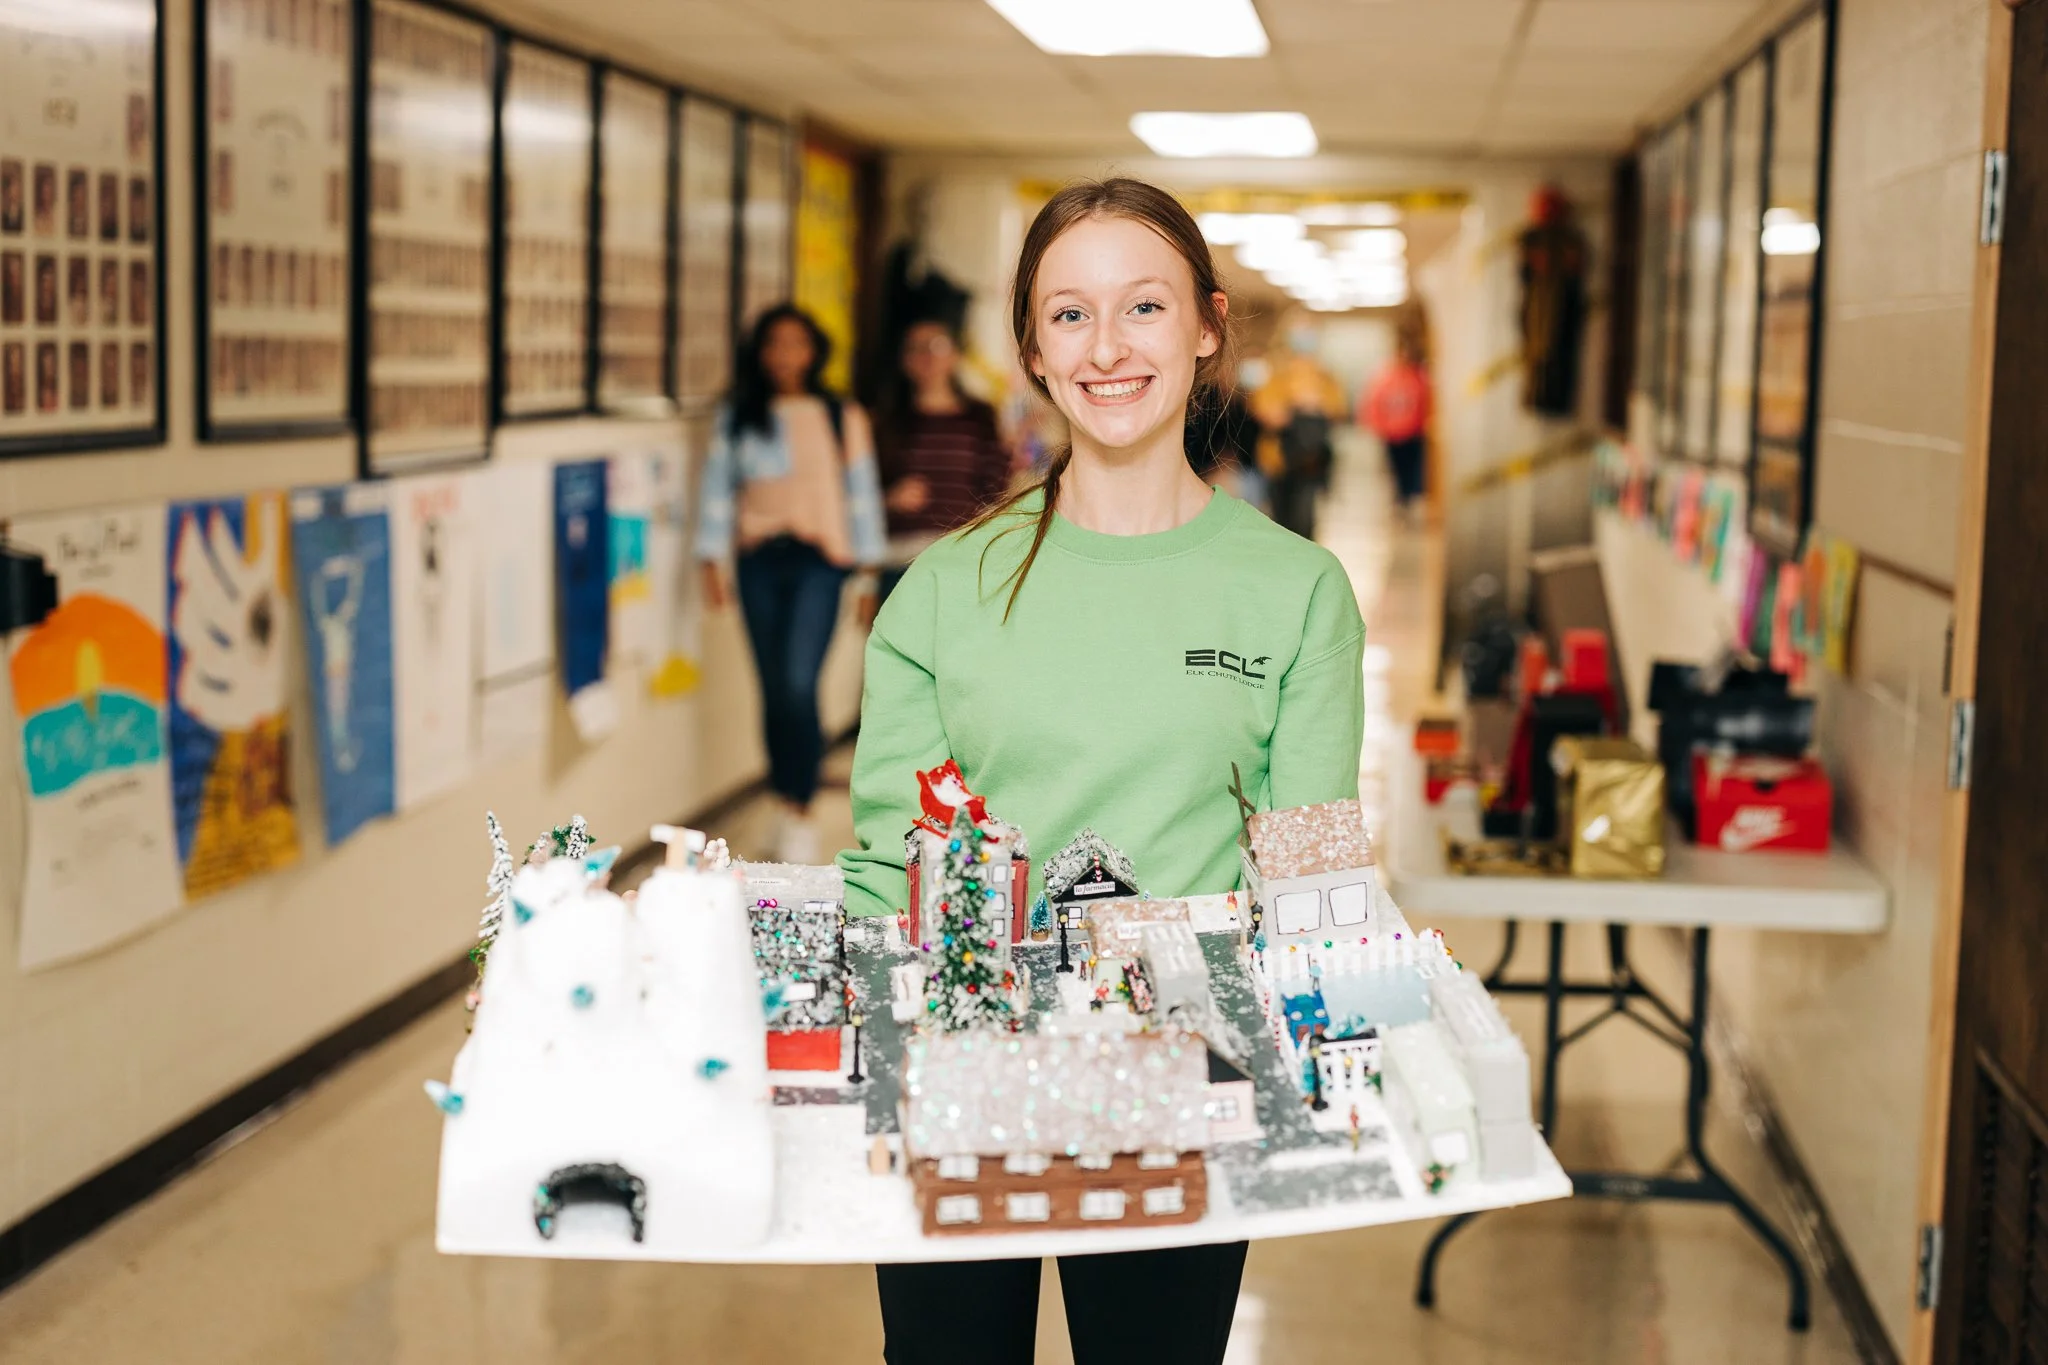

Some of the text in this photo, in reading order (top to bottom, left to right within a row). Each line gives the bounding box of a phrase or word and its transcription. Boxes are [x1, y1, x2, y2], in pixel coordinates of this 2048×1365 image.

[1185, 649, 1266, 680] ECL
[1208, 670, 1238, 681] CHUTE
[1239, 678, 1265, 689] LODGE
